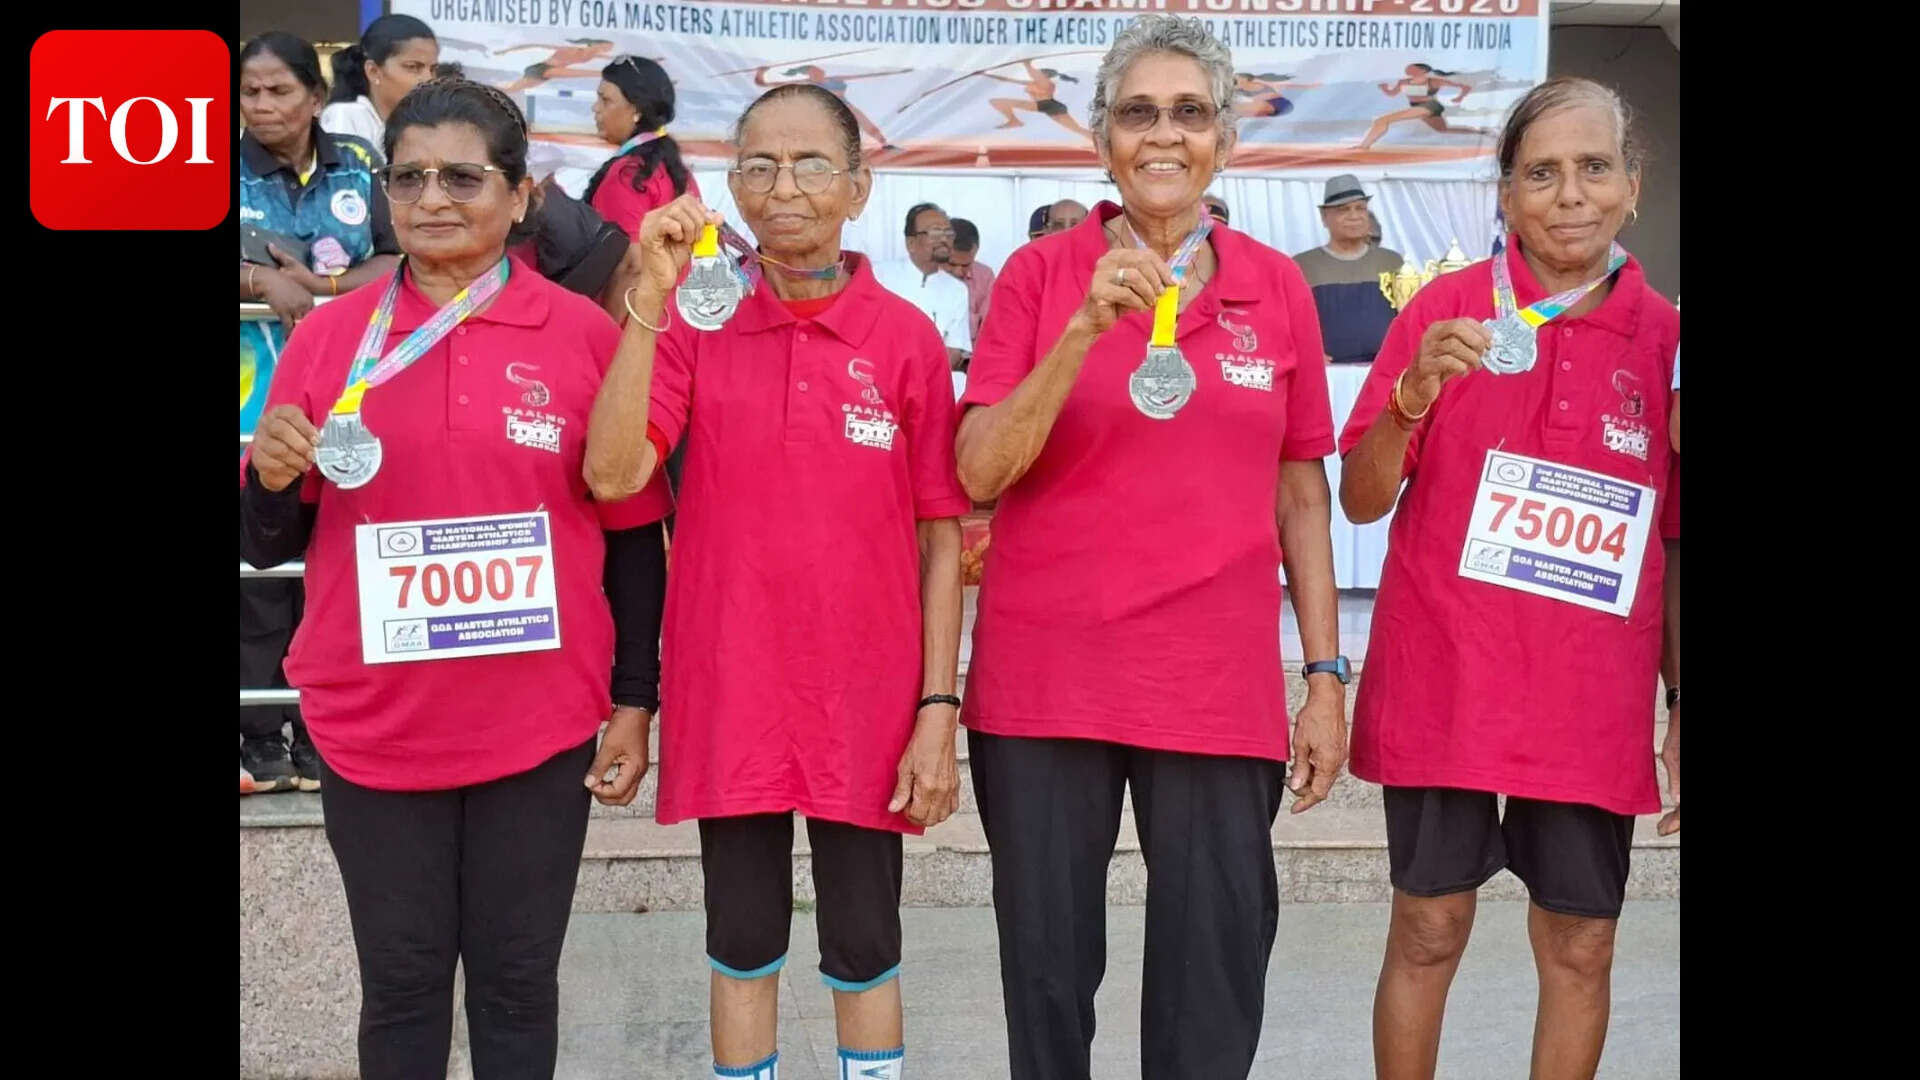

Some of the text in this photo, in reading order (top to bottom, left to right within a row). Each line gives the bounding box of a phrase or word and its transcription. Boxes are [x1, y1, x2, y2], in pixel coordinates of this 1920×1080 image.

[431, 0, 541, 24] ORGANISED
[550, 0, 573, 26] BY
[579, 0, 618, 28] GOA
[624, 3, 713, 35] MASTERS
[720, 9, 809, 40] ATHLETIC
[815, 13, 940, 44] ASSOCIATION
[947, 16, 1007, 45] UNDER
[1014, 18, 1048, 44] THE
[1055, 18, 1106, 45] AEGIS
[1222, 20, 1319, 47] ATHLETICS
[1326, 21, 1434, 49] FEDERATION
[1441, 22, 1462, 49] OF
[1468, 23, 1512, 50] INDIA
[1535, 483, 1610, 504] CHAMPIONSHIP
[1541, 476, 1629, 503] MASTER ATHLETICS
[1554, 470, 1601, 488] NATIONAL
[1604, 483, 1636, 497] WOMEN
[433, 530, 531, 543] MASTER ATHLETICS
[446, 525, 496, 535] NATIONAL
[499, 521, 537, 531] WOMEN
[1488, 492, 1628, 562] 75004
[430, 539, 509, 551] CHAMPIONSHIP
[389, 555, 543, 609] 70007
[1512, 555, 1617, 586] GOA MASTER ATHLETICS
[1534, 570, 1594, 590] ASSOCIATION
[431, 614, 549, 633] GOA MASTER ATHLETICS
[458, 627, 524, 641] ASSOCIATION
